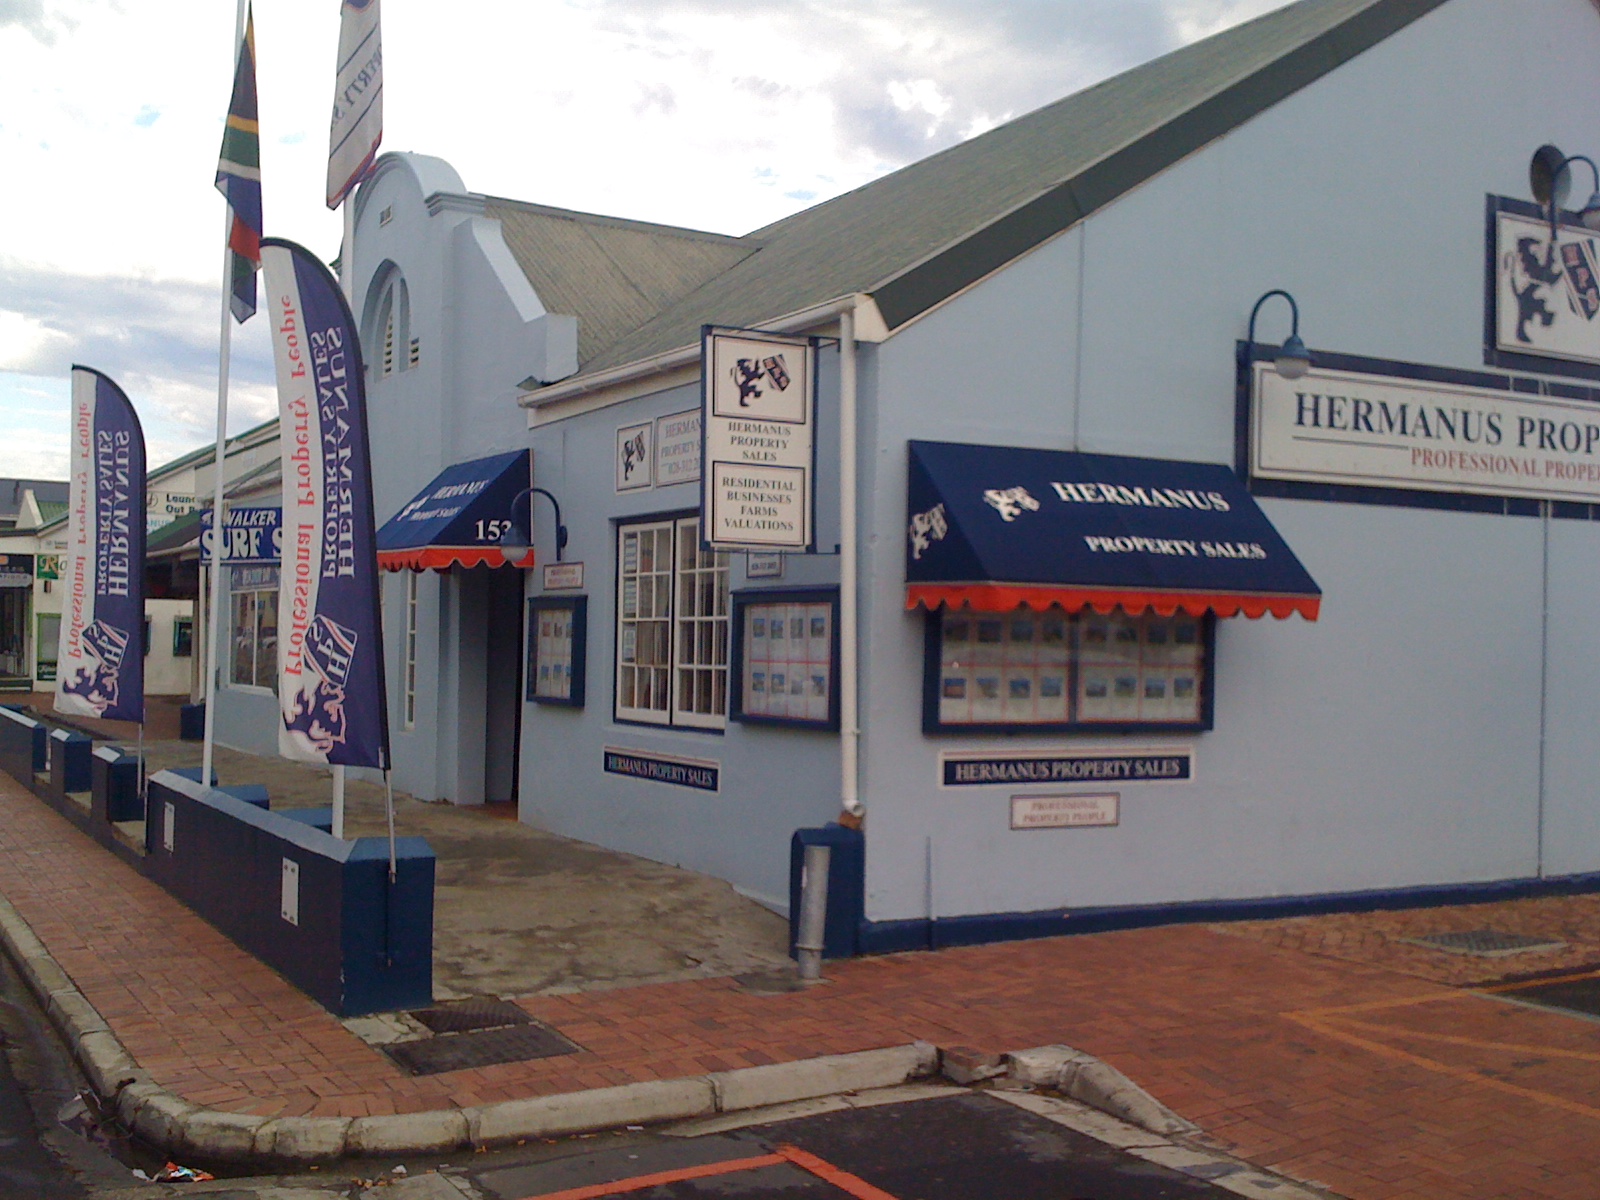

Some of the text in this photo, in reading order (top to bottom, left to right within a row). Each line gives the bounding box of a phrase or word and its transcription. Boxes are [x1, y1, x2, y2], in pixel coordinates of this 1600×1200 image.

[728, 421, 792, 436] HERMANUS
[1293, 391, 1600, 454] HERMANUS PROP
[730, 436, 789, 450] PROPERTY
[742, 449, 777, 462] SALES
[1411, 447, 1540, 478] PROFESSIONAL
[722, 476, 796, 491] RESIDENTIAL
[727, 491, 792, 504] BUSINESSES
[1050, 481, 1231, 512] HERMANUS
[740, 504, 778, 517] FARMS
[724, 518, 794, 531] VALUATIONS
[201, 527, 263, 560] SURF
[1084, 535, 1267, 560] PROPERTY SALES
[955, 758, 1181, 782] HERMANUS PROPERTY SALES
